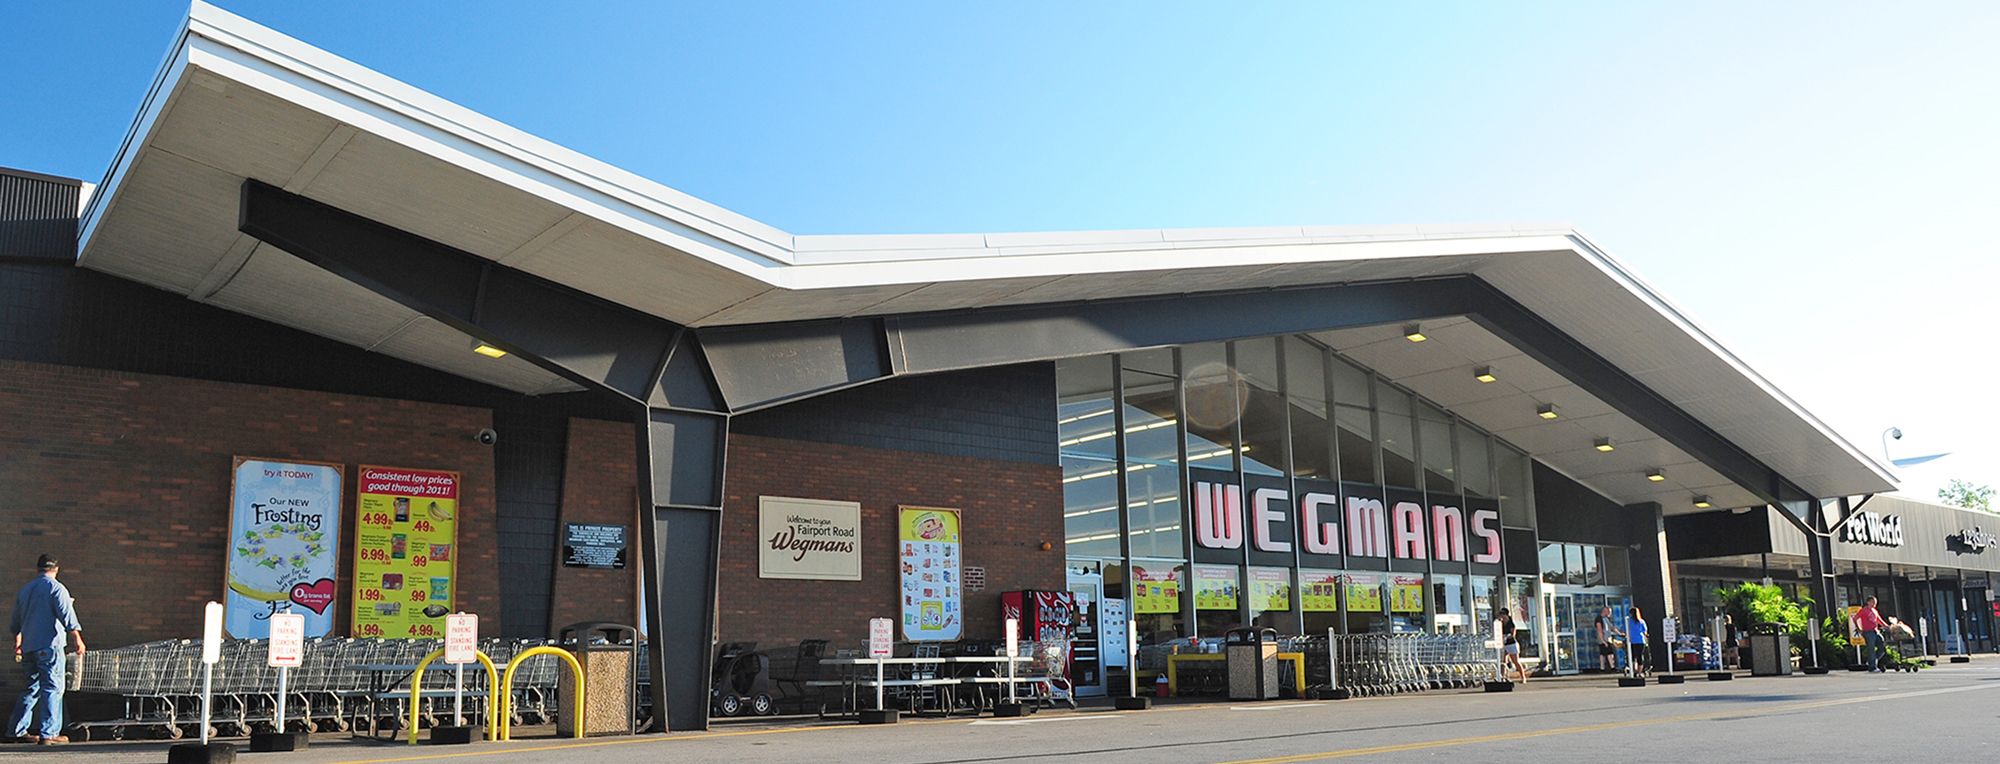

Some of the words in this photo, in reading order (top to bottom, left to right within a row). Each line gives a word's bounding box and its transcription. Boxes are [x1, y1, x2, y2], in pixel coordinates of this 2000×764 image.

[264, 469, 275, 478] try
[284, 471, 313, 479] TODAY!
[366, 471, 411, 481] Consistent
[412, 474, 428, 482] low
[428, 476, 453, 485] prices
[368, 483, 390, 491] good
[391, 483, 424, 495] through
[426, 486, 450, 495] 2011!
[270, 497, 285, 505] Our
[251, 503, 322, 531] Frosting
[787, 515, 812, 524] Welcome
[1193, 481, 1500, 564] WEGMANS
[798, 525, 831, 537] Fairport
[833, 527, 854, 537] Road
[1847, 514, 1868, 542] Pet
[1864, 511, 1904, 546] World
[768, 526, 854, 561] Wegmans
